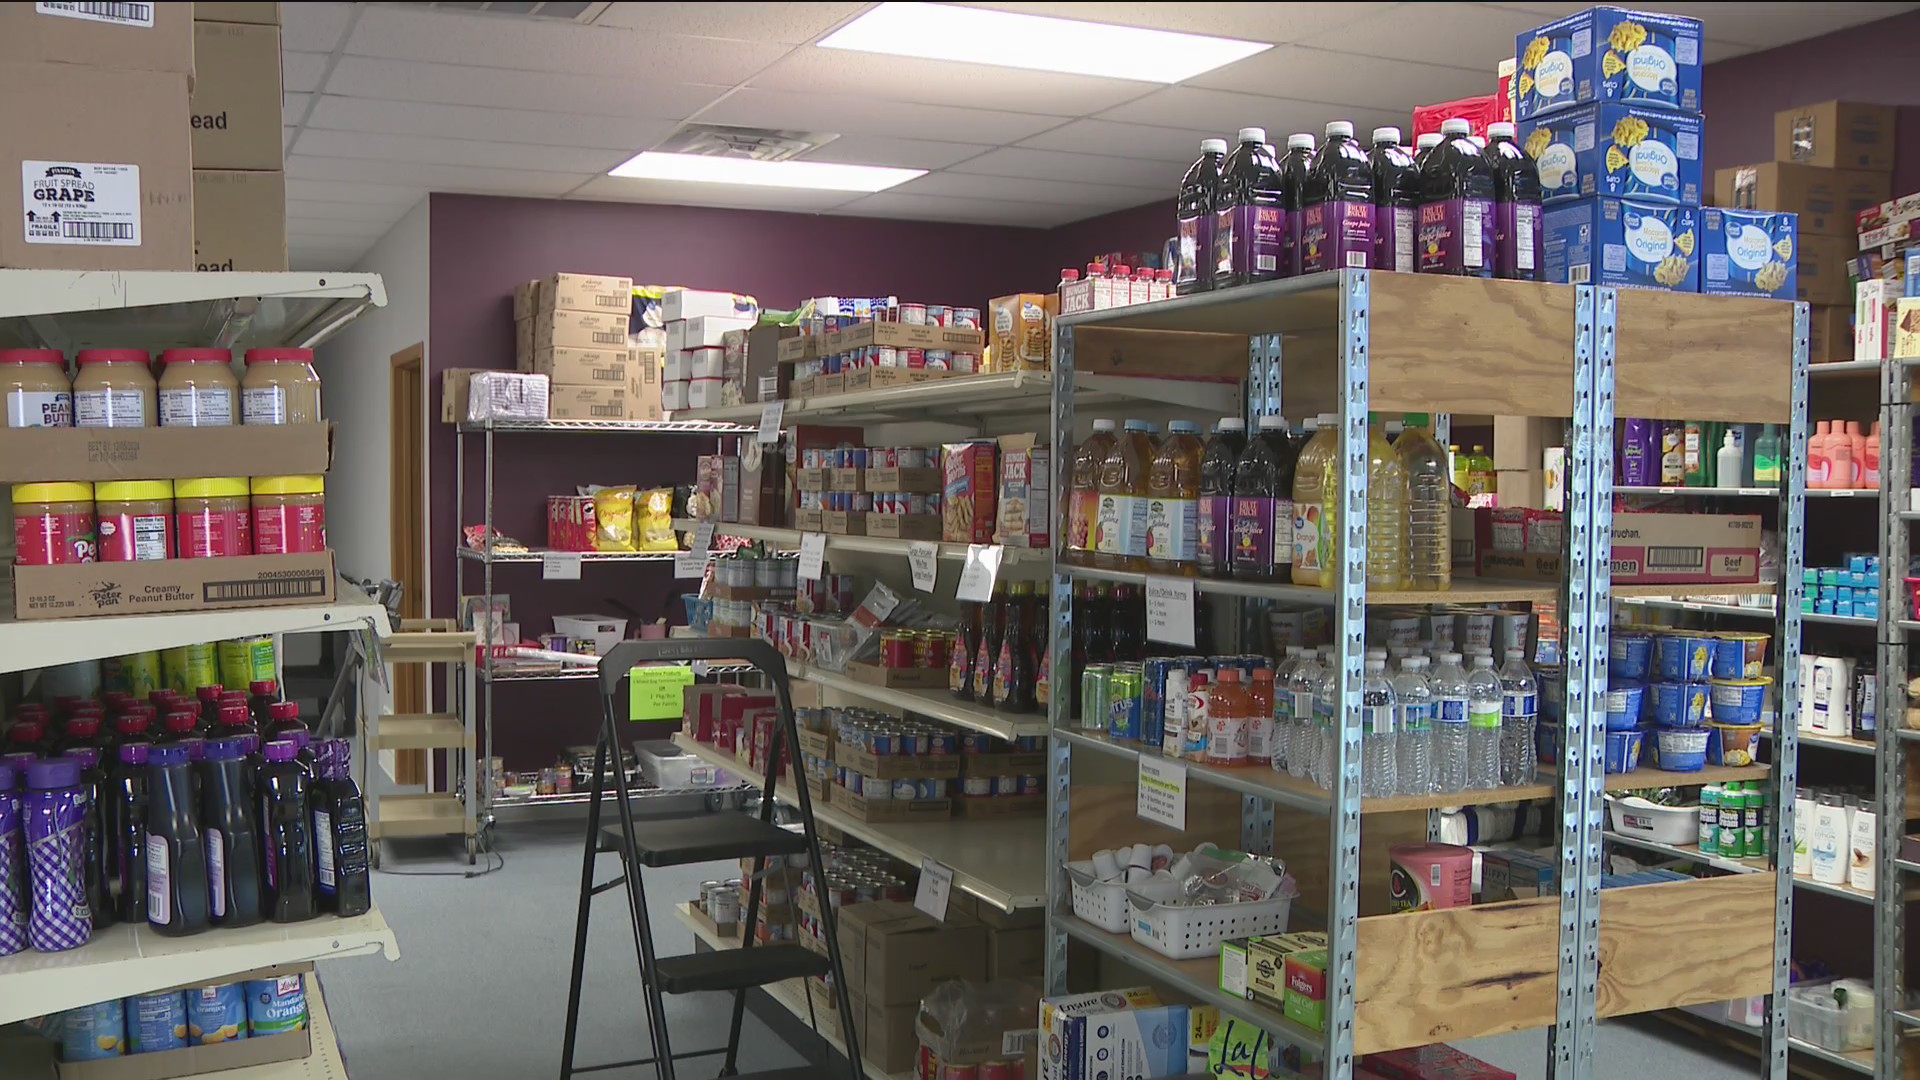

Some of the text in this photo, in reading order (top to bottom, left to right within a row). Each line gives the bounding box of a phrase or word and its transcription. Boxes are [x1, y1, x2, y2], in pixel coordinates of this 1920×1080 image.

[1632, 56, 1665, 70] Original
[1635, 151, 1667, 165] Original
[33, 179, 95, 190] FRUIT SPREAD
[33, 188, 95, 202] GRAPE
[1636, 238, 1667, 251] Original
[1737, 247, 1767, 260] Original
[194, 259, 232, 271] ead
[1064, 294, 1090, 312] JACK
[1004, 463, 1026, 479] JACK
[1296, 533, 1316, 543] Orange
[1724, 556, 1742, 566] Beef
[92, 591, 122, 601] Peter
[144, 585, 181, 595] Creamy
[129, 593, 194, 604] Peanut Butter
[1485, 864, 1507, 881] JIFFY
[1291, 975, 1313, 993] Folgers
[1059, 998, 1097, 1012] Ensure
